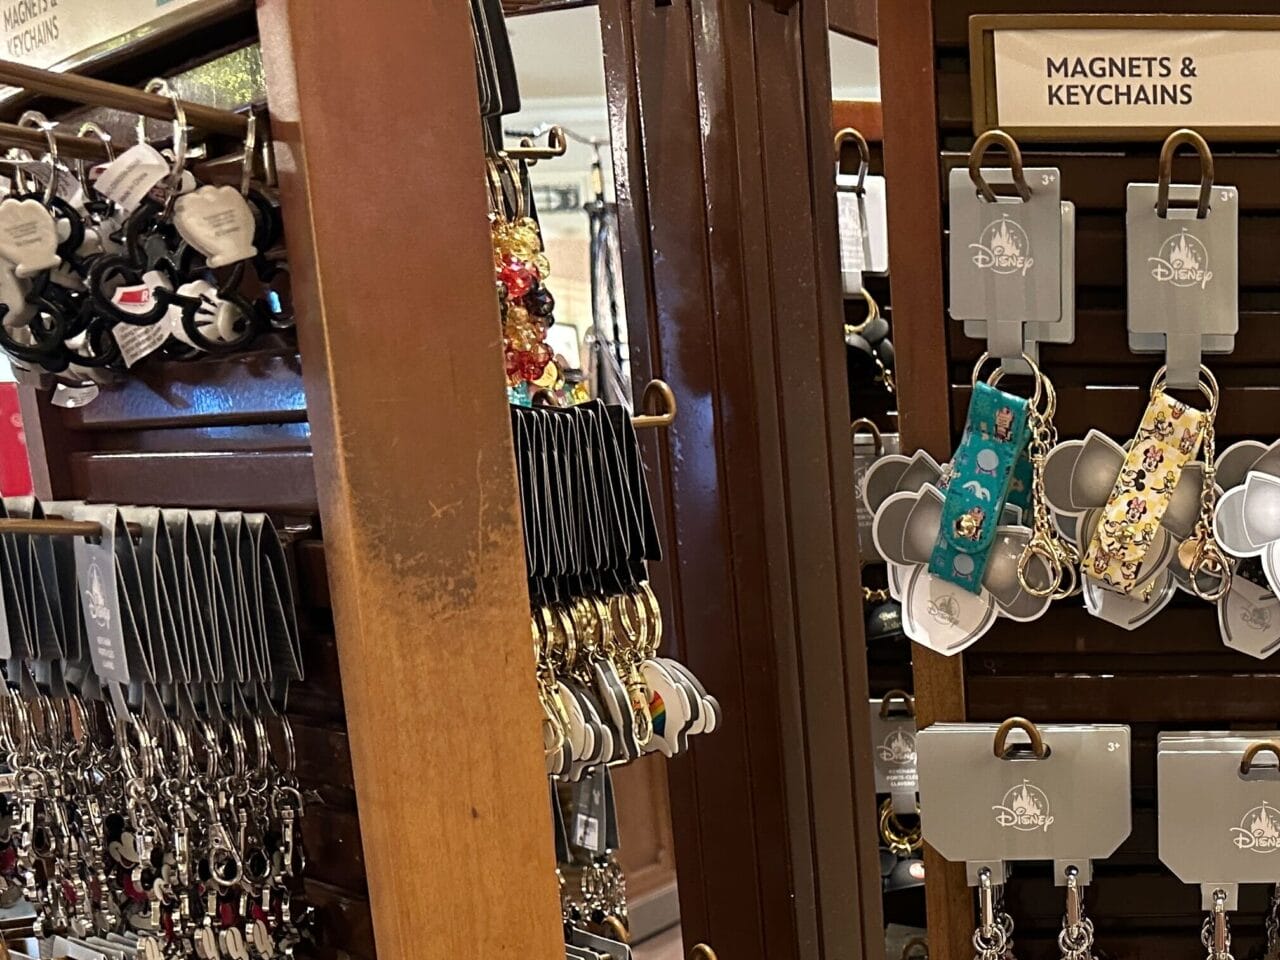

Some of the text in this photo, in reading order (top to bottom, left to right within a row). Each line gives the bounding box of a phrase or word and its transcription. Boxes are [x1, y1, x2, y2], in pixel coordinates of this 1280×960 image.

[7, 15, 59, 57] KEYCHAINS
[1046, 57, 1197, 78] MAGNETS &
[1047, 84, 1193, 105] KEYCHAINS
[1041, 174, 1056, 186] 3+
[1220, 190, 1234, 202] 3+
[968, 243, 1034, 276] Disney
[1148, 257, 1213, 290] Disney
[1107, 741, 1120, 752] 3+
[991, 804, 1055, 833] Disney
